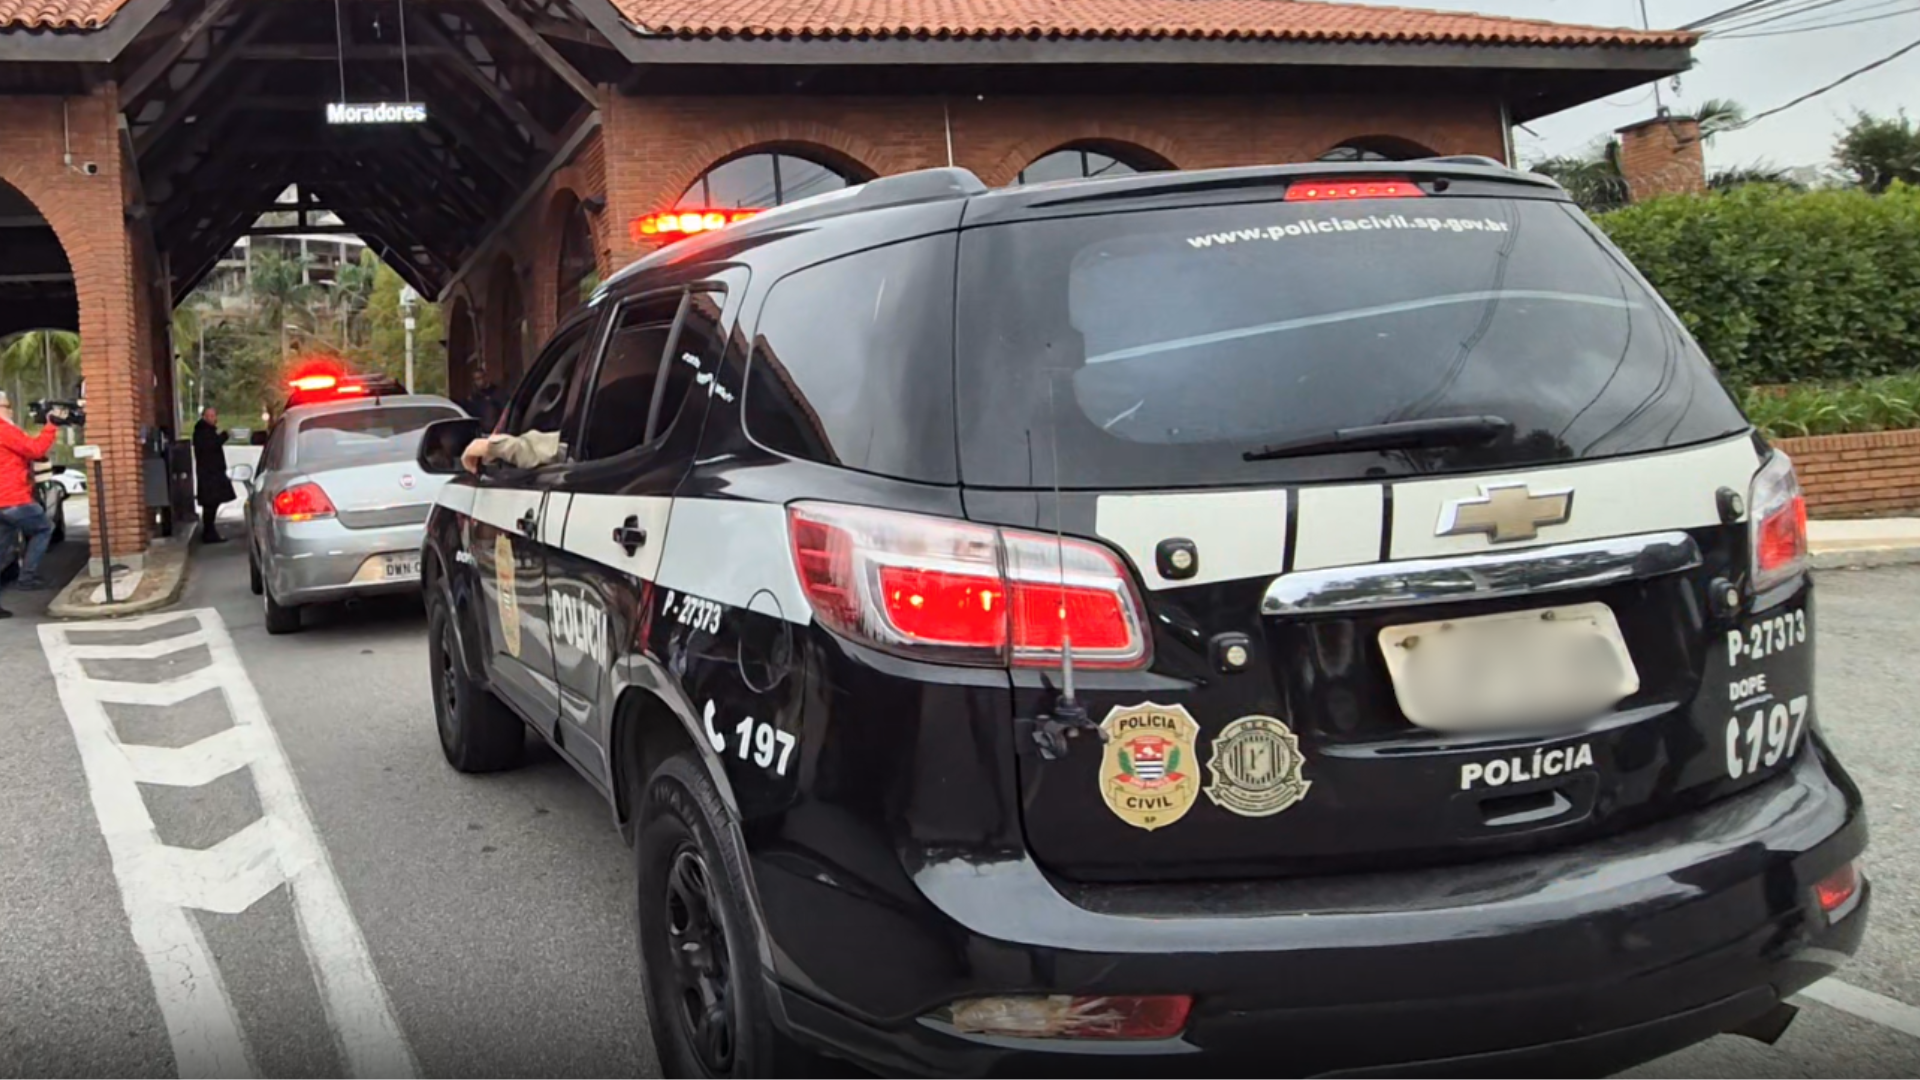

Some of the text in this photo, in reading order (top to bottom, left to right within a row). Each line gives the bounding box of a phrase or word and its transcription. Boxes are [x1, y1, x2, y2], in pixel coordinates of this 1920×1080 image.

[326, 102, 426, 123] Moradores
[1727, 608, 1806, 667] P-27373
[1729, 673, 1767, 701] DOPE
[1118, 714, 1176, 732] POLÍCIA
[1746, 695, 1808, 774] 197
[736, 716, 796, 776] 197
[1460, 743, 1593, 790] POLÍCIA
[1126, 795, 1173, 810] CIVIL
[1144, 815, 1157, 824] SP
